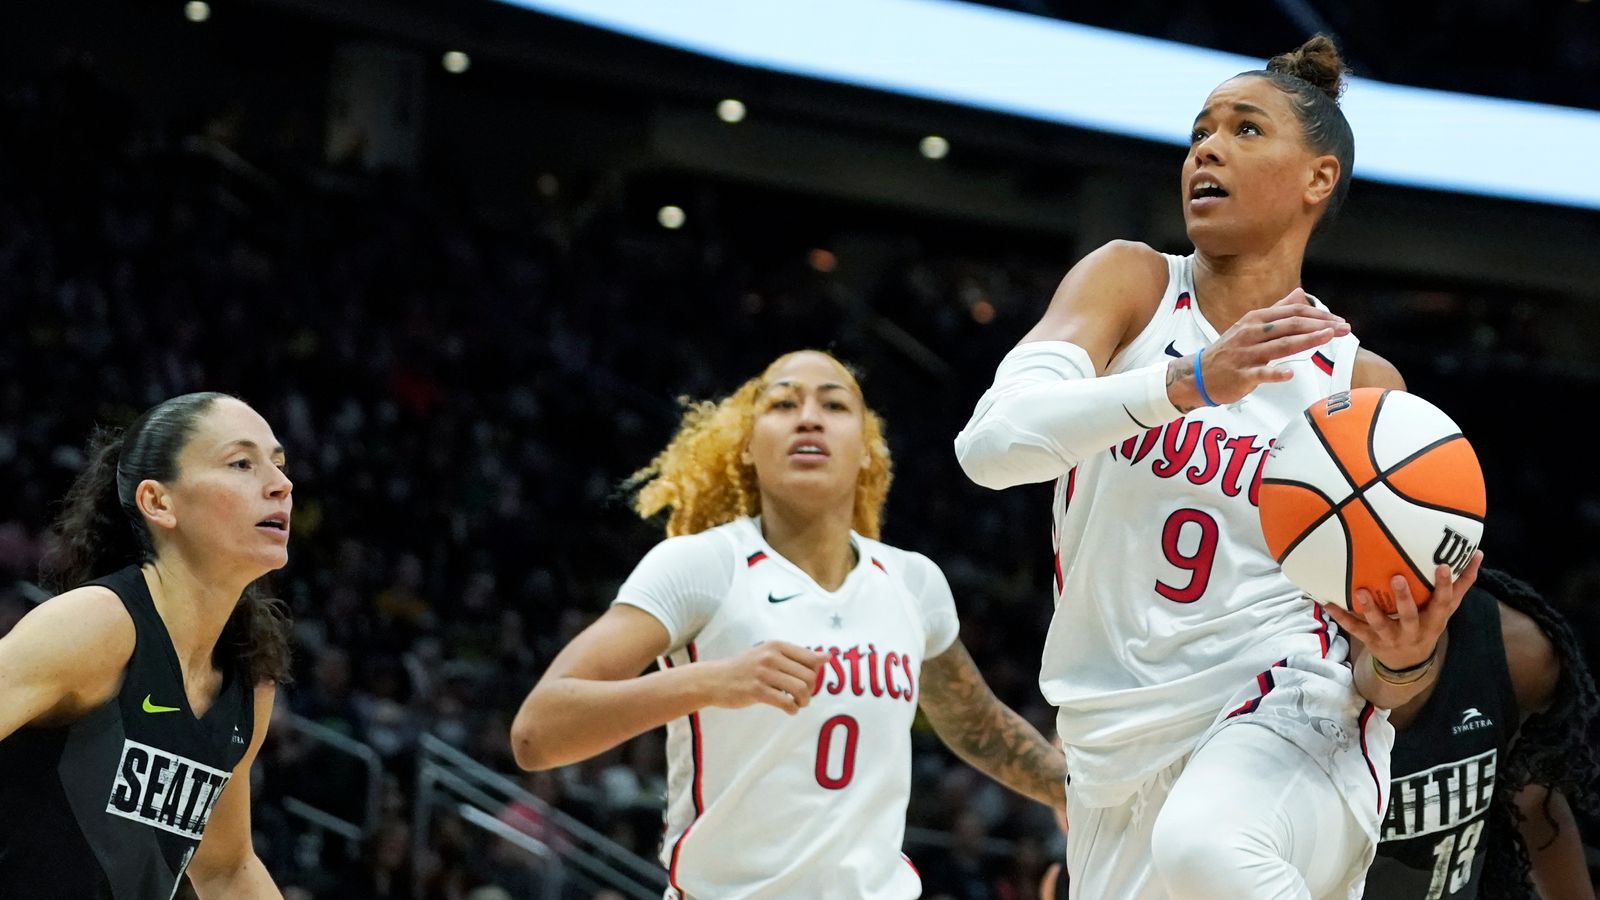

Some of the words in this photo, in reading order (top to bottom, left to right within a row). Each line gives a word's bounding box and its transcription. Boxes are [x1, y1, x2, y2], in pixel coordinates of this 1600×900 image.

[1154, 508, 1219, 604] 9
[815, 714, 860, 790] 0
[1452, 718, 1494, 736] SYMETRA
[110, 746, 230, 836] SEATT
[1425, 819, 1486, 900] 13
